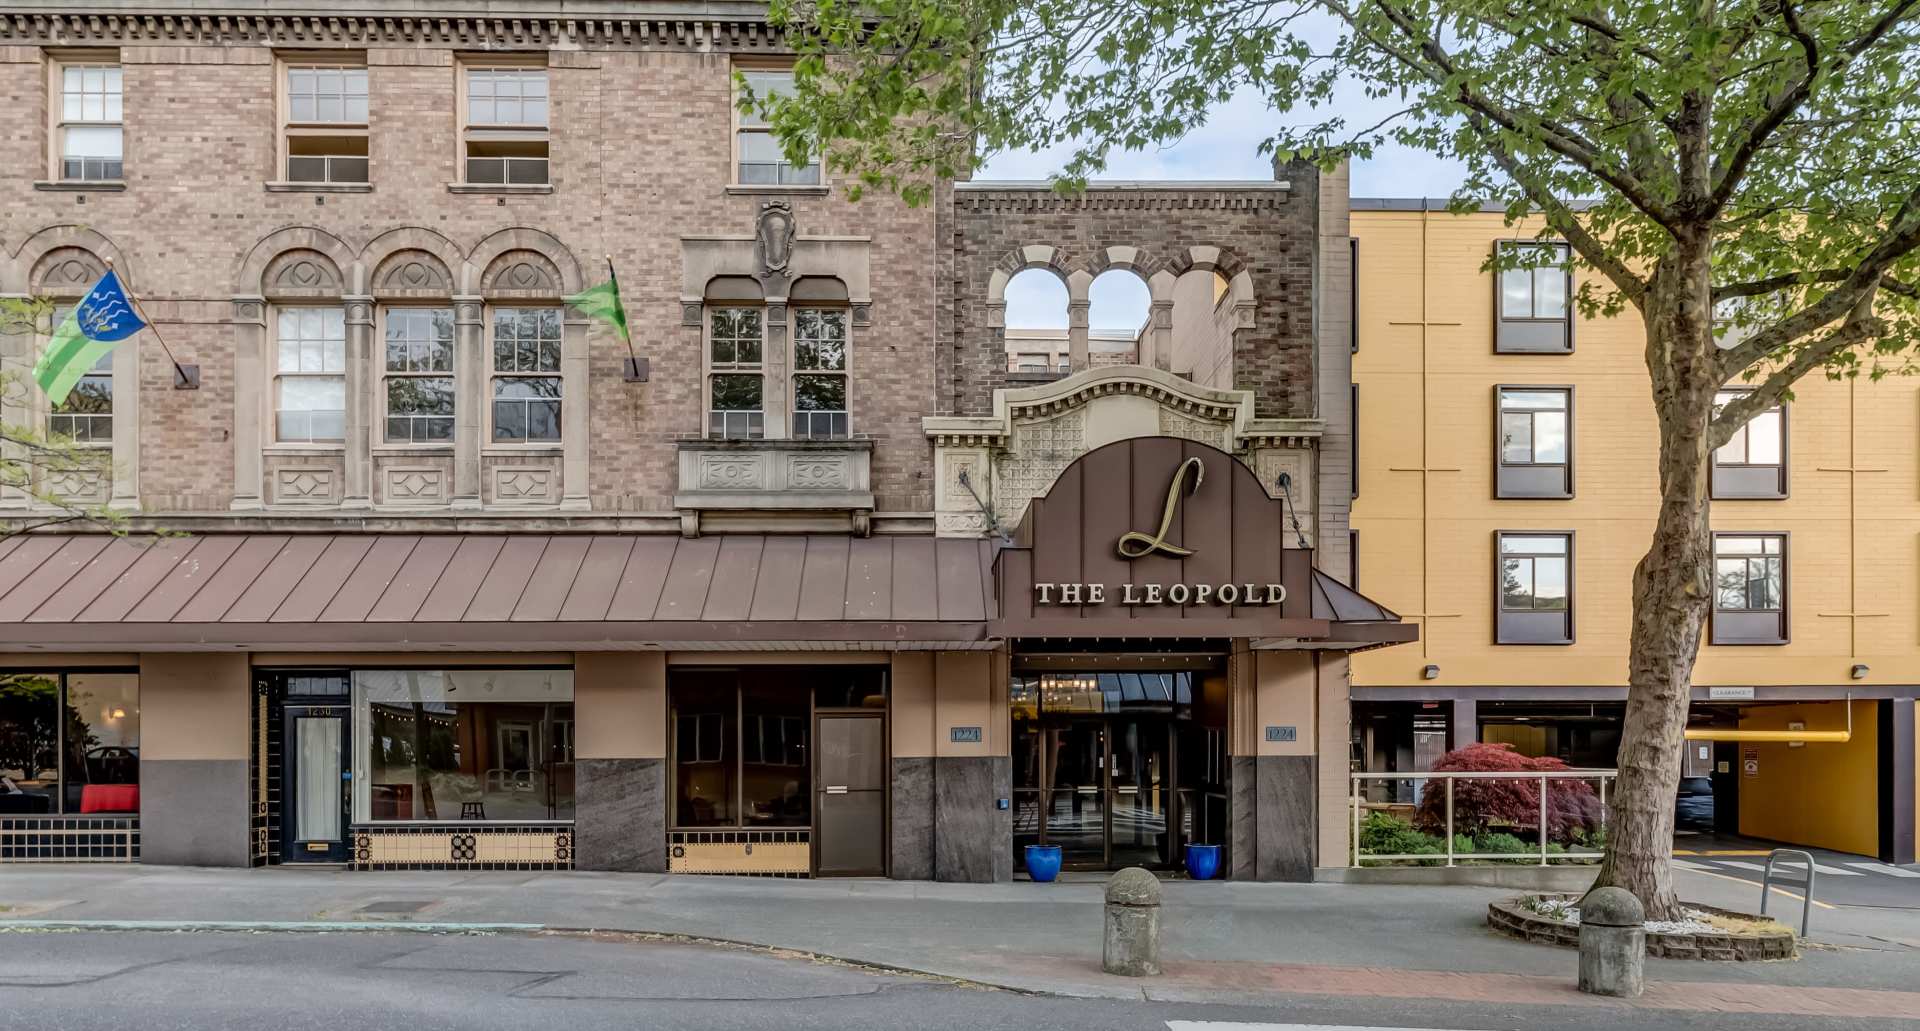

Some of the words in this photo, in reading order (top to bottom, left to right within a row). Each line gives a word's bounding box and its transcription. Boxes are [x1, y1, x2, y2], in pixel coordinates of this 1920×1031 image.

[1117, 456, 1206, 559] L
[1035, 583, 1105, 604] THE
[1122, 583, 1287, 604] LEOPOLD
[954, 729, 979, 741] 1224
[1269, 728, 1293, 740] 1224
